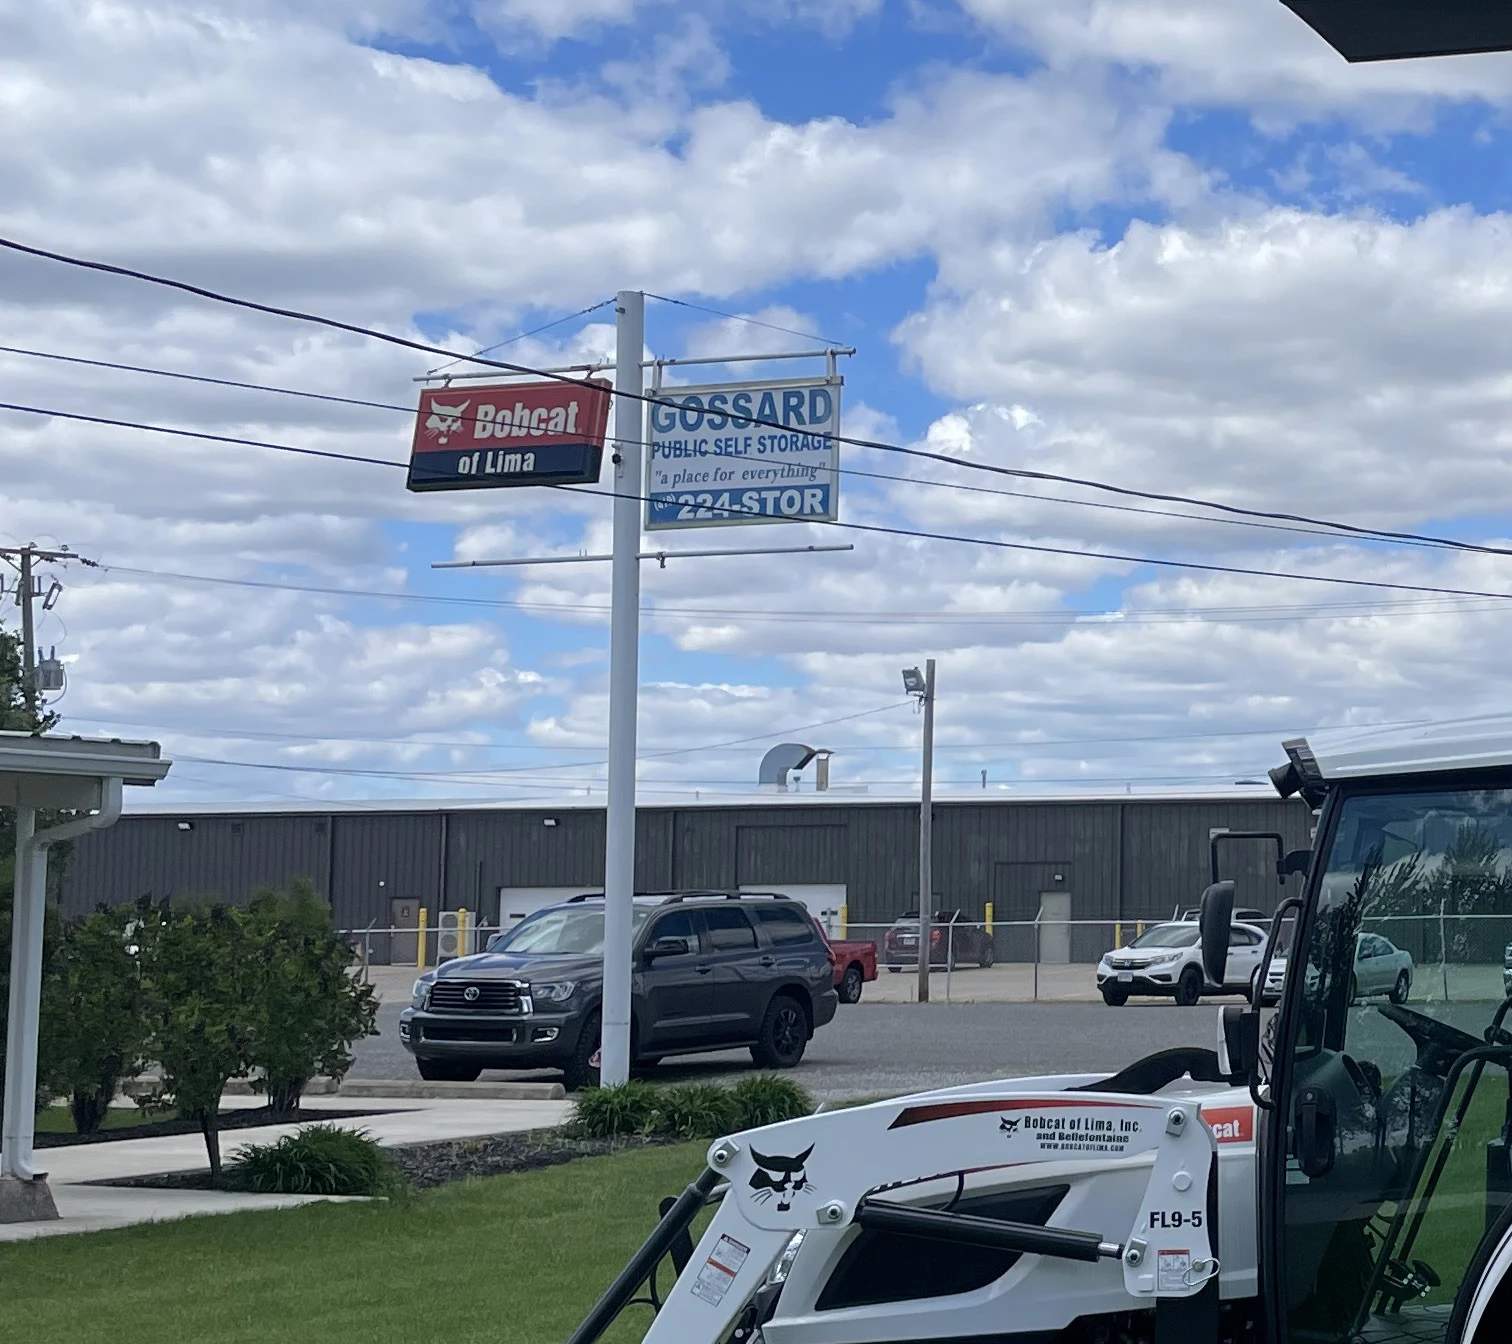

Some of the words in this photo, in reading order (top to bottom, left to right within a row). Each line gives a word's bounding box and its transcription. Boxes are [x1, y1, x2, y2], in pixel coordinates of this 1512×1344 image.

[473, 401, 579, 439] Bobcat
[651, 388, 832, 434] GOSSARD
[652, 438, 709, 460] PUBLIC
[713, 436, 752, 456] SELF
[757, 432, 833, 454] STORAGE
[457, 451, 481, 475] of
[484, 450, 535, 474] Lima
[671, 468, 709, 489] place
[712, 467, 736, 482] for
[676, 488, 824, 520] 224-STOR
[1024, 1115, 1066, 1130] Bobcat
[1069, 1117, 1081, 1131] of
[1120, 1118, 1142, 1132] Inc.
[1211, 1119, 1240, 1139] cat
[1036, 1131, 1056, 1141] and
[1058, 1131, 1130, 1143] Bellefontaine
[1149, 1210, 1203, 1229] FL9-5
